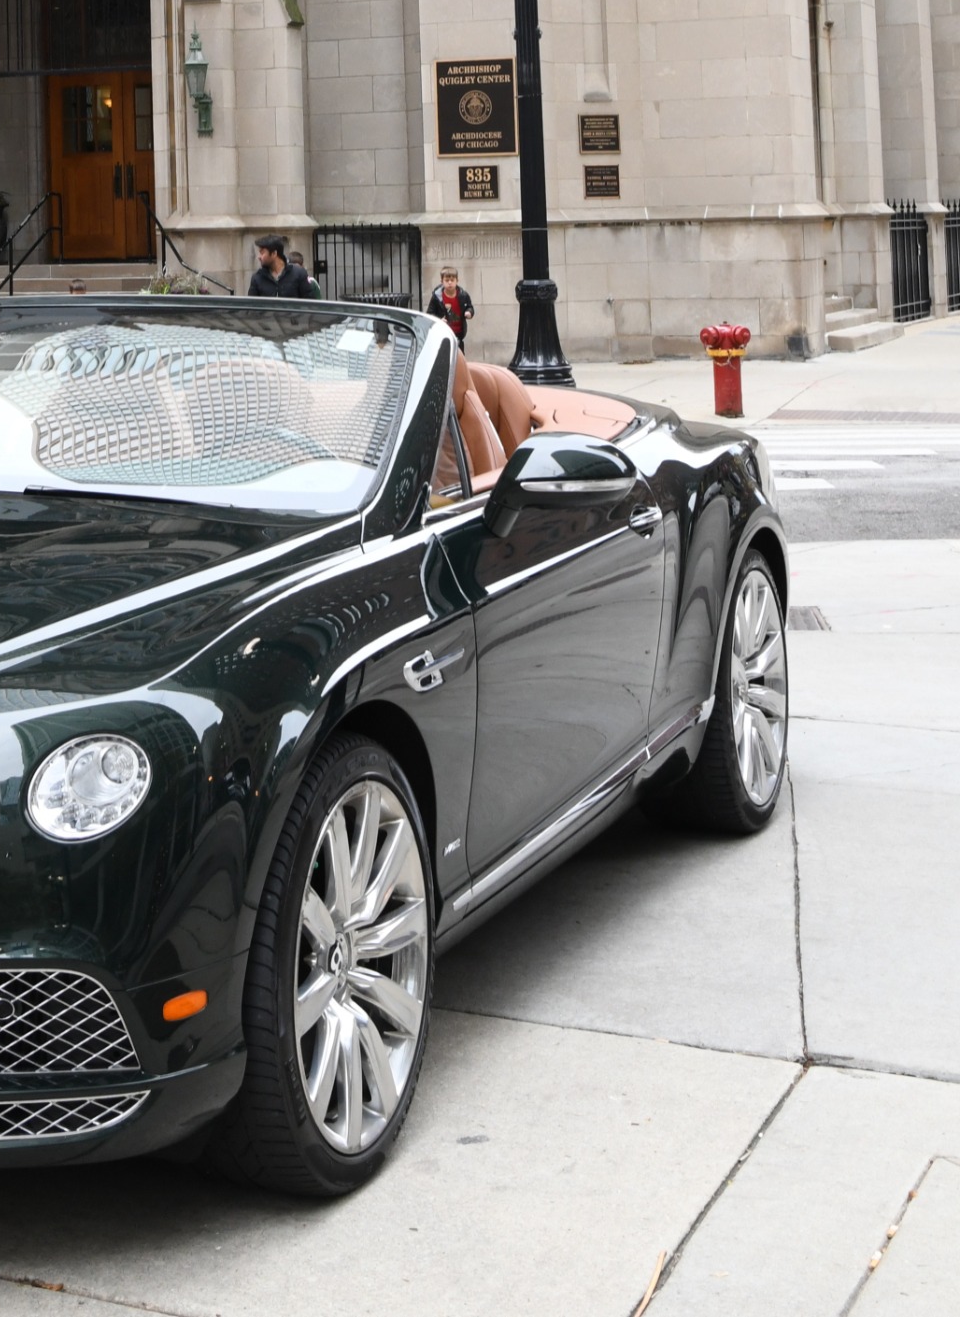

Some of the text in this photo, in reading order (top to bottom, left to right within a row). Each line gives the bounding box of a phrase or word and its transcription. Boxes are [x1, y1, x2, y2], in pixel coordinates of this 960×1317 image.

[447, 65, 501, 74] ARCHBISHOP
[439, 74, 510, 86] QUIGLEY CENTER
[451, 131, 502, 140] ARCHDIOCESE
[455, 140, 499, 149] OF CHICAGO
[466, 168, 491, 182] 835
[464, 190, 483, 198] RUSH
